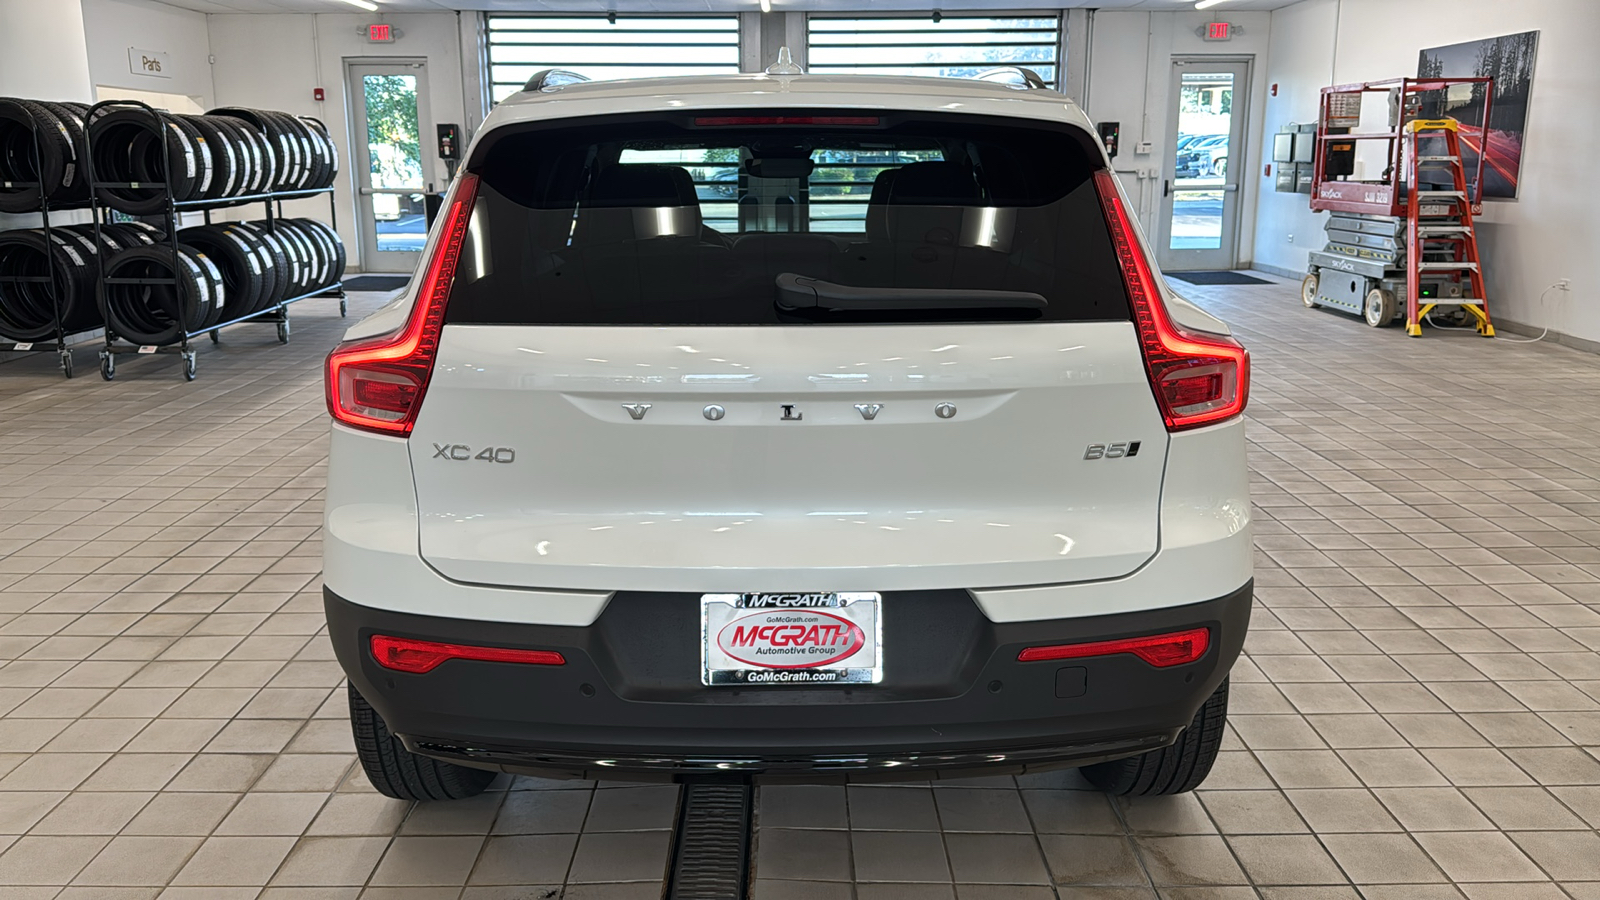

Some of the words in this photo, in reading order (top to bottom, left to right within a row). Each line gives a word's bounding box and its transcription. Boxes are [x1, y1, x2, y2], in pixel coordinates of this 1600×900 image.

[370, 24, 390, 40] EXIT
[1209, 22, 1229, 39] EXIT
[142, 55, 162, 72] Parts
[622, 402, 957, 421] VOLVO
[755, 646, 806, 655] Automotive
[808, 646, 836, 656] Group
[748, 671, 836, 682] GoMcGrath.com
